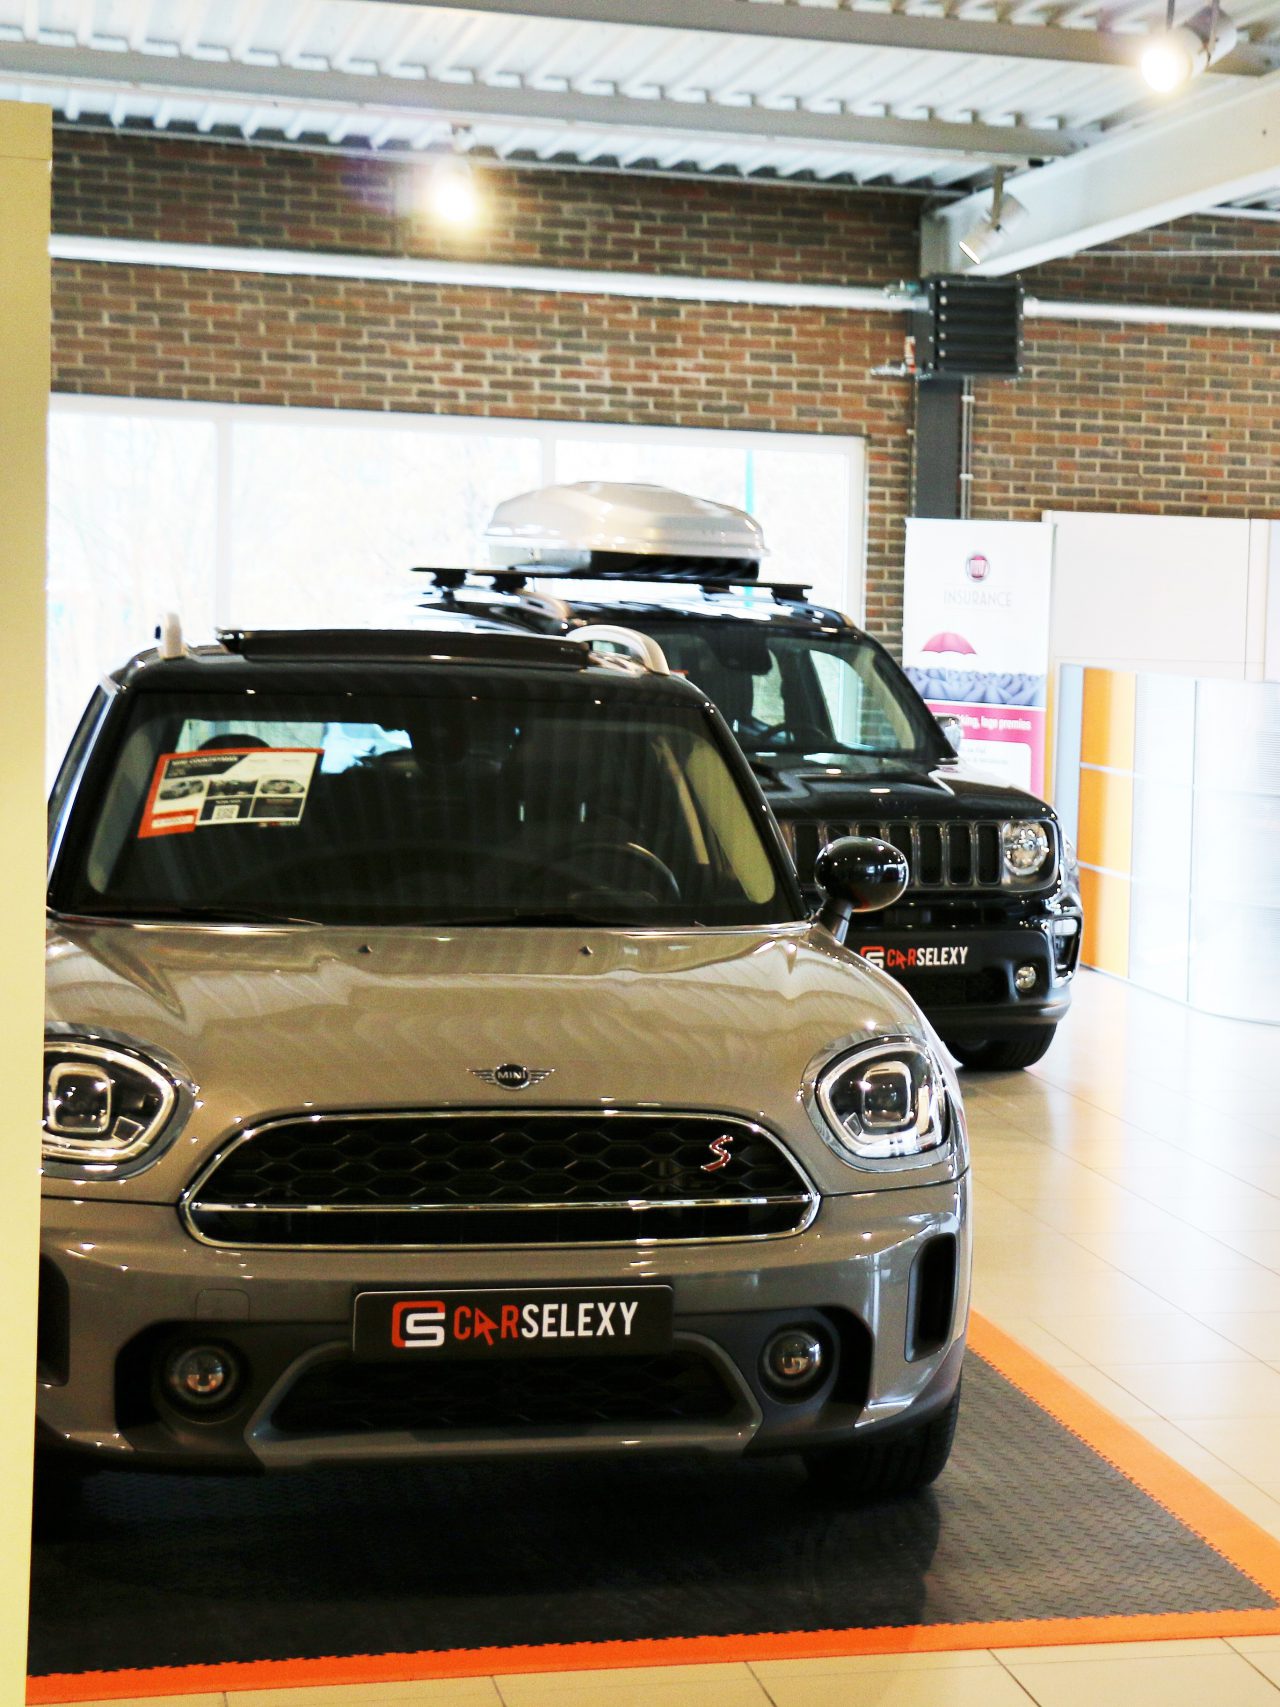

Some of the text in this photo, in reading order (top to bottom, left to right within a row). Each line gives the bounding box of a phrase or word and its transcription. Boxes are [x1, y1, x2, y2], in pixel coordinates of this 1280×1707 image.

[943, 589, 1012, 608] INSURANCE
[497, 1071, 526, 1079] MINI
[453, 1301, 638, 1346] CARSELEXY
